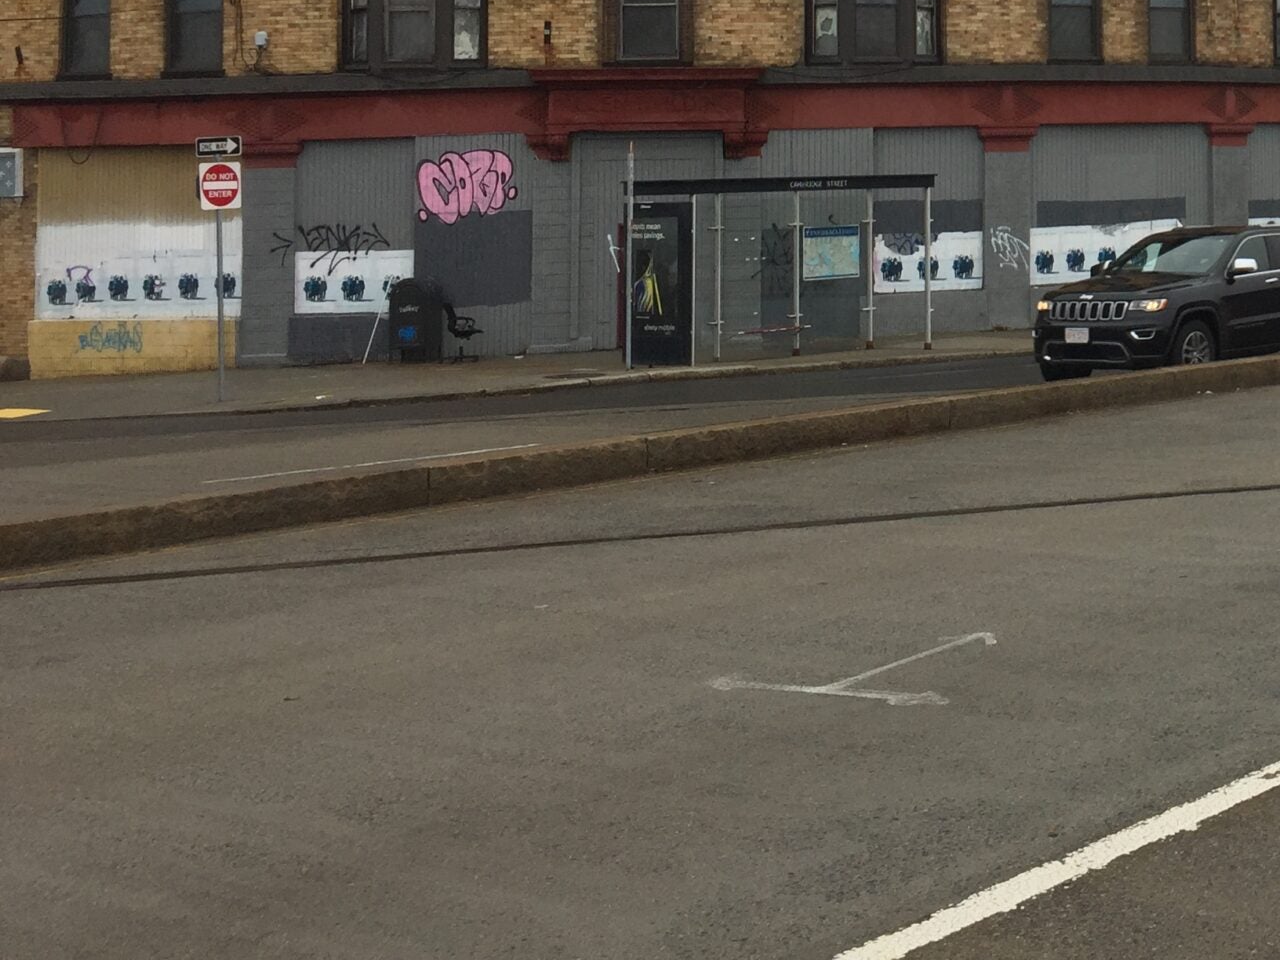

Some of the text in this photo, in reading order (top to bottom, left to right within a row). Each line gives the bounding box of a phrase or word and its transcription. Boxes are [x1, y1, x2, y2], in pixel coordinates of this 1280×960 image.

[205, 172, 235, 180] DO NOT
[208, 190, 233, 198] ENTER
